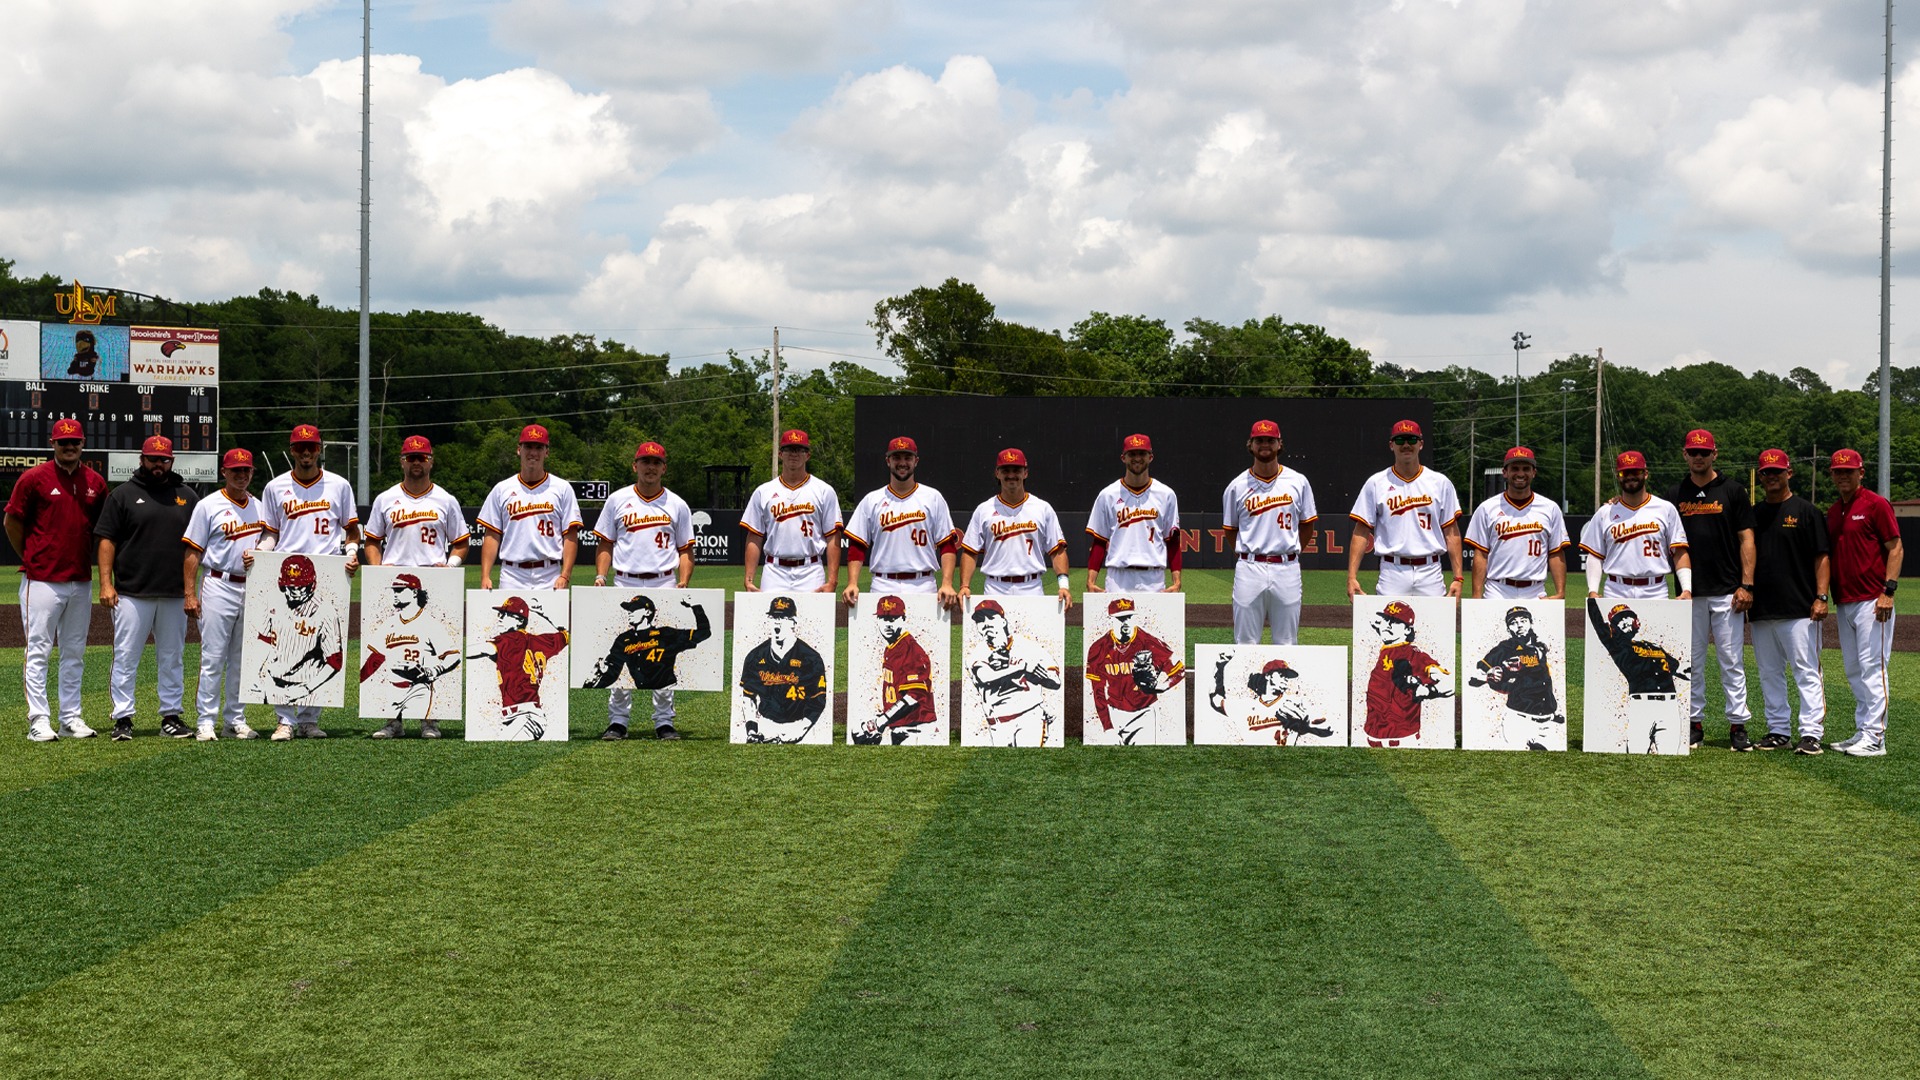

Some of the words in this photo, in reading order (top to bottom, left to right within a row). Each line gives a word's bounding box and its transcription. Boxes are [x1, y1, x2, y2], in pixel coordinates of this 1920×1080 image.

[176, 332, 194, 340] Super
[133, 363, 215, 376] WARHAWKS
[25, 381, 47, 391] BALL
[79, 383, 110, 393] STRIKE
[137, 385, 155, 395] OUT
[190, 387, 205, 396] H/E
[9, 411, 14, 419] 1
[20, 411, 26, 419] 2
[32, 411, 38, 420] 3
[47, 411, 53, 420] 4
[59, 412, 65, 420] 5
[71, 412, 77, 420] 6
[88, 412, 94, 421] 7
[100, 413, 105, 421] 8
[110, 413, 117, 422] 9
[143, 414, 163, 423] RUNS
[173, 415, 190, 423] HITS
[198, 416, 213, 424] ERR
[0, 456, 47, 467] RADE
[195, 467, 215, 476] Bank
[283, 499, 331, 516] Warhawks
[507, 500, 554, 516] Warhawks
[771, 502, 815, 518] Warhawks
[1244, 493, 1293, 511] Warhawks
[390, 508, 439, 524] Warhawks
[622, 512, 671, 528] Warhawks
[880, 509, 926, 526] Warhawks
[1277, 512, 1292, 531] 43
[1417, 512, 1432, 531] 51
[314, 517, 330, 535] 12
[537, 519, 555, 537] 48
[991, 520, 1037, 536] Warhawks
[1495, 520, 1543, 535] Warhawks
[1610, 522, 1660, 539] Warhawks
[420, 526, 437, 545] 22
[655, 531, 670, 549] 47
[694, 535, 728, 548] RION
[911, 528, 928, 547] 40
[702, 548, 728, 556] BANK
[1025, 538, 1034, 555] 7
[1528, 539, 1541, 557] 10
[1643, 540, 1660, 558] 25
[294, 619, 316, 637] ULM
[404, 649, 420, 663] 22
[646, 648, 665, 662] 47
[786, 685, 806, 700] 45
